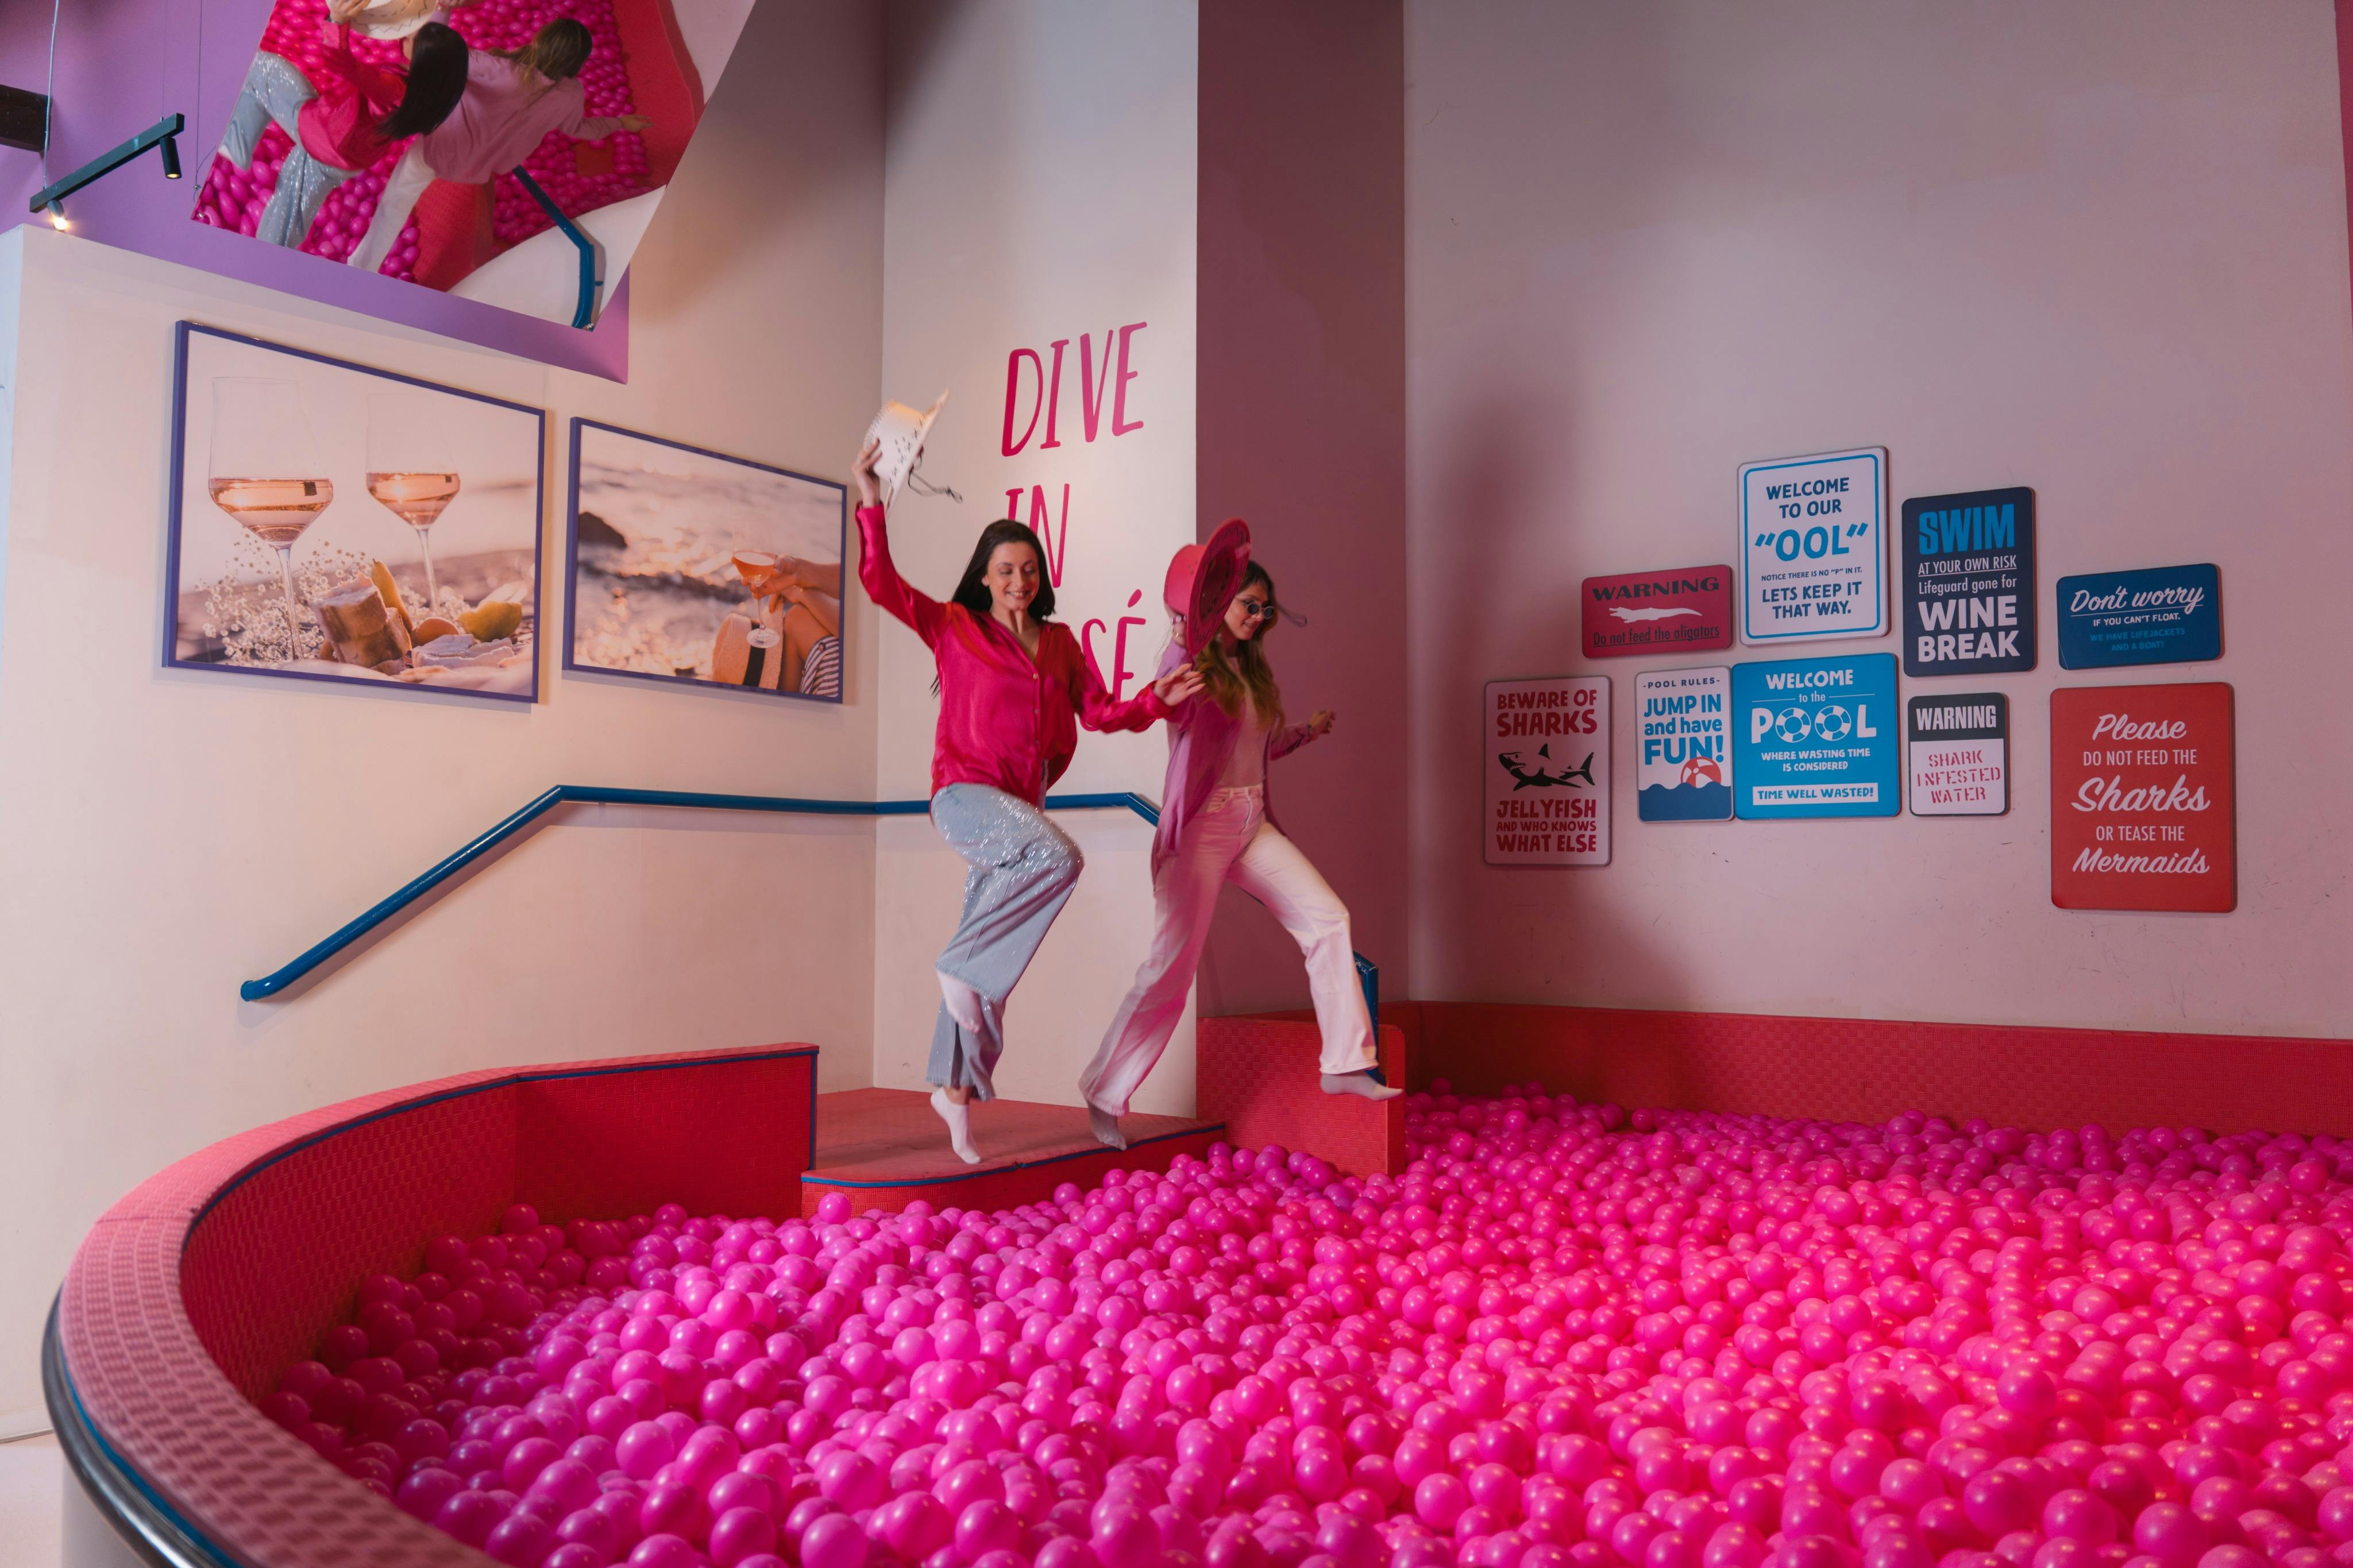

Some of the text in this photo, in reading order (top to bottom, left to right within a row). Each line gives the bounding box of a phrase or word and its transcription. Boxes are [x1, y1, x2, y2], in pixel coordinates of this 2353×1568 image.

[1001, 321, 1147, 457] DIVE
[1766, 477, 1849, 500] WELCOME
[1779, 499, 1842, 519] TO OUR
[1919, 504, 2015, 555] SWIM
[1755, 523, 1868, 561] "OOL"
[1918, 555, 2016, 575] AT YOUR OWN RISK
[1592, 577, 1719, 601] WARNING
[1762, 581, 1862, 603] LETS KEEP IT
[1919, 574, 2017, 596] Lifeguard gone for
[1773, 601, 1851, 619] THAT WAY.
[2070, 586, 2204, 615] Don't worry
[1918, 595, 2017, 631] WINE
[2124, 615, 2149, 624] CAN'T
[2153, 613, 2180, 621] FLOAT.
[1594, 625, 1719, 645] Do not feed the aligators
[2131, 628, 2185, 638] LIFEJACKETS
[1918, 631, 2020, 662] BREAK
[2140, 641, 2164, 649] BOAT!
[1766, 669, 1853, 690] WELCOME
[1498, 689, 1596, 709] BEWARE OF
[1644, 694, 1721, 717] JUMP IN
[1799, 692, 1825, 702] to the
[1497, 709, 1597, 737] SHARKS
[1645, 717, 1722, 736] and have
[1751, 705, 1876, 744] POOL
[1916, 705, 1996, 731] WARNING
[2093, 713, 2186, 741] Please
[1645, 735, 1723, 765] FUN!
[1761, 748, 1870, 761] WHERE WASTING TIME
[1928, 750, 1983, 767] SHARK
[2084, 750, 2197, 766] DO NOT FEED THE
[1783, 762, 1848, 771] IS CONSIDERED
[1918, 767, 2000, 786] INFESTED
[1758, 787, 1873, 800] TIME WELL WASTED!
[1931, 787, 1985, 804] WATER
[2071, 774, 2210, 812] Sharks
[1496, 799, 1596, 818] JELLYFISH
[1496, 821, 1596, 832] AND WHO KNOWS
[2096, 826, 2184, 841] OR TEASE THE
[1496, 834, 1596, 852] WHAT ELSE
[2073, 847, 2210, 874] Mermaids
